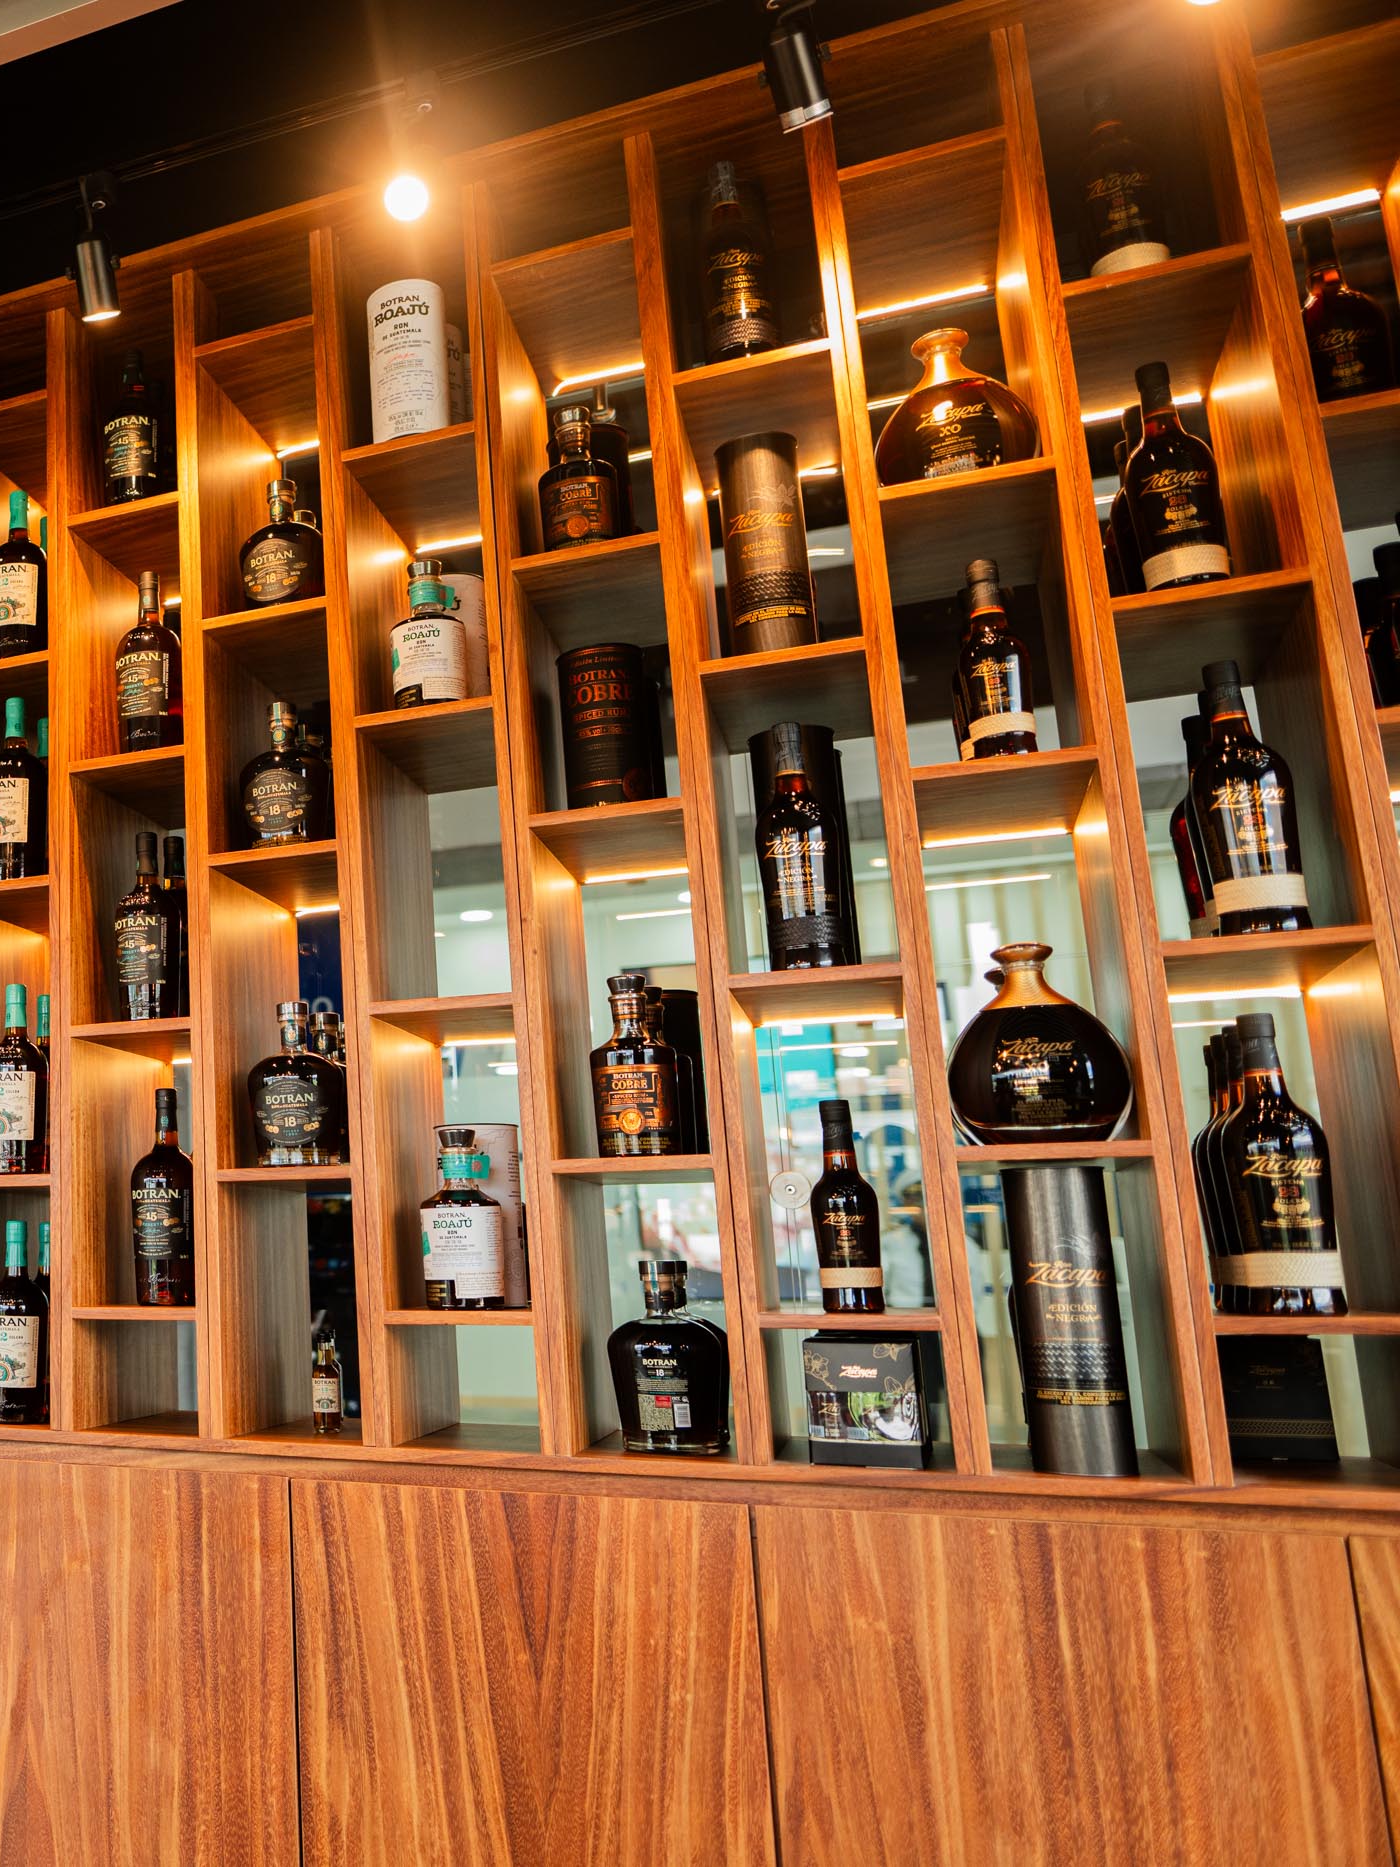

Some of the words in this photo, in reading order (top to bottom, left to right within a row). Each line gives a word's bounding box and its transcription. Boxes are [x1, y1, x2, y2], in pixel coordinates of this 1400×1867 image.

[380, 295, 420, 310] BOTRAN
[374, 302, 430, 328] ROAJÚ
[393, 322, 409, 330] RON
[915, 402, 985, 432] Zcapa
[104, 416, 149, 435] BOTRAN
[938, 424, 962, 437] XO
[118, 437, 130, 445] 15
[1140, 470, 1209, 497] Zacapa
[728, 512, 793, 539] Zacapa
[250, 551, 294, 568] BOTRAN
[265, 573, 278, 584] 18
[407, 625, 435, 633] BOTRAN
[403, 629, 441, 643] ROAJÚ
[115, 653, 159, 671] BOTRAN
[127, 674, 139, 683] 15
[569, 682, 631, 708] OBR
[252, 782, 297, 797] BOTRAN
[1209, 785, 1287, 812] Zacapa
[269, 804, 281, 816] 18
[763, 840, 826, 860] Zacapa
[114, 917, 156, 932] BOTRAN
[124, 940, 136, 949] 15
[999, 1040, 1075, 1059] Zacapa
[611, 1078, 648, 1090] COBRE
[265, 1093, 314, 1105] BOTRAN
[284, 1116, 297, 1127] 18
[1242, 1156, 1322, 1178] Zacapa
[132, 1189, 179, 1200] BOTRAN
[145, 1212, 158, 1222] 15
[438, 1212, 464, 1220] BOTRAN
[822, 1212, 865, 1226] Zacapa
[433, 1217, 473, 1229] ROAJÚ
[1024, 1262, 1105, 1288] Zacapa
[1050, 1302, 1098, 1313] EDICIÓN
[1056, 1313, 1095, 1322] NEGRA
[642, 1358, 678, 1366] BOTRAN
[655, 1368, 665, 1377] 18
